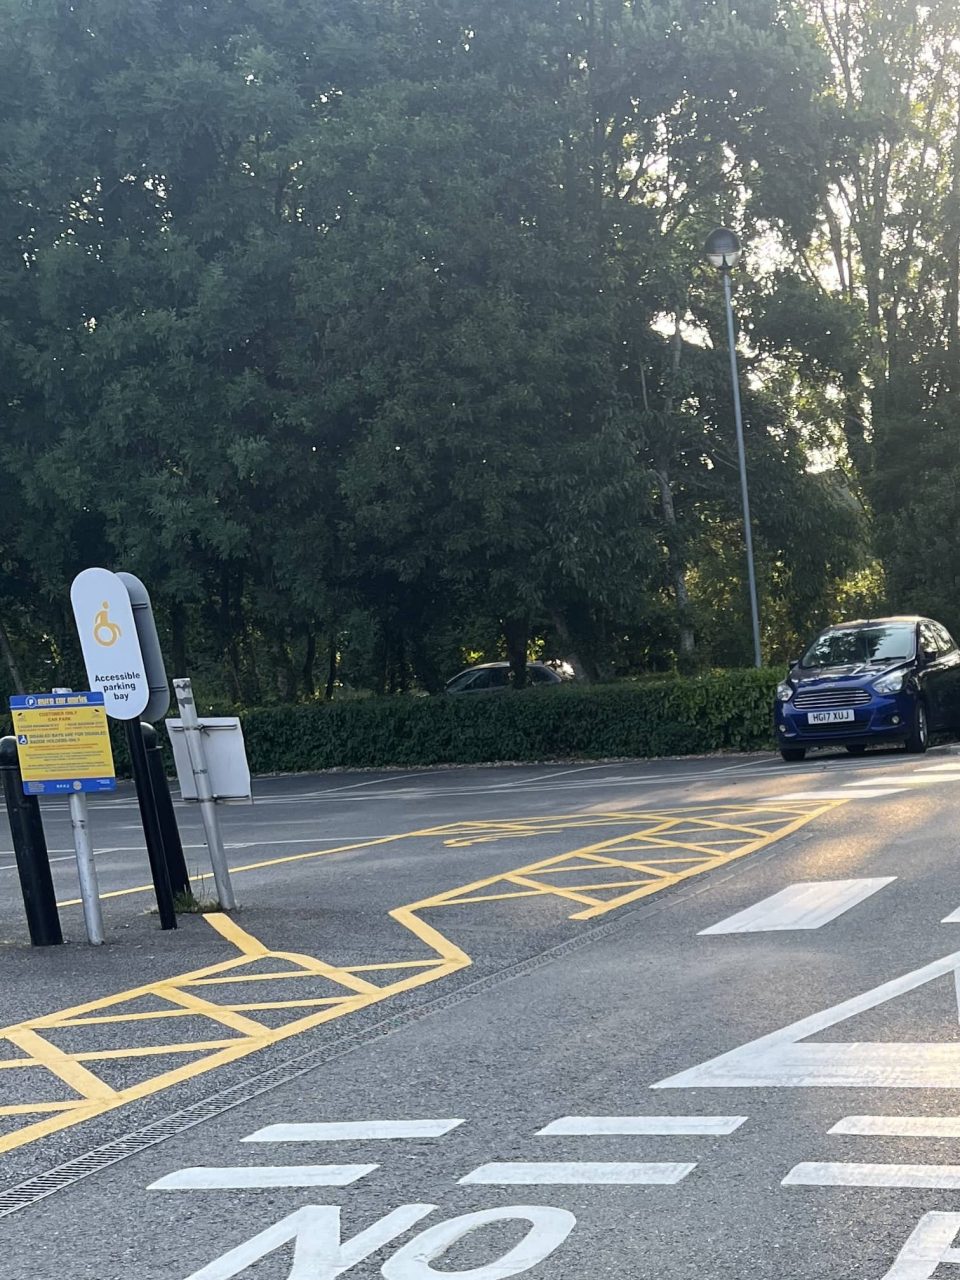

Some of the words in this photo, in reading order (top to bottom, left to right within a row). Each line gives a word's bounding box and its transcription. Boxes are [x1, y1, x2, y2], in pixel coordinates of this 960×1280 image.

[95, 672, 141, 682] Accessible
[103, 682, 136, 693] parking
[114, 692, 129, 701] bay
[813, 712, 831, 722] HG17
[833, 711, 849, 720] XUJ
